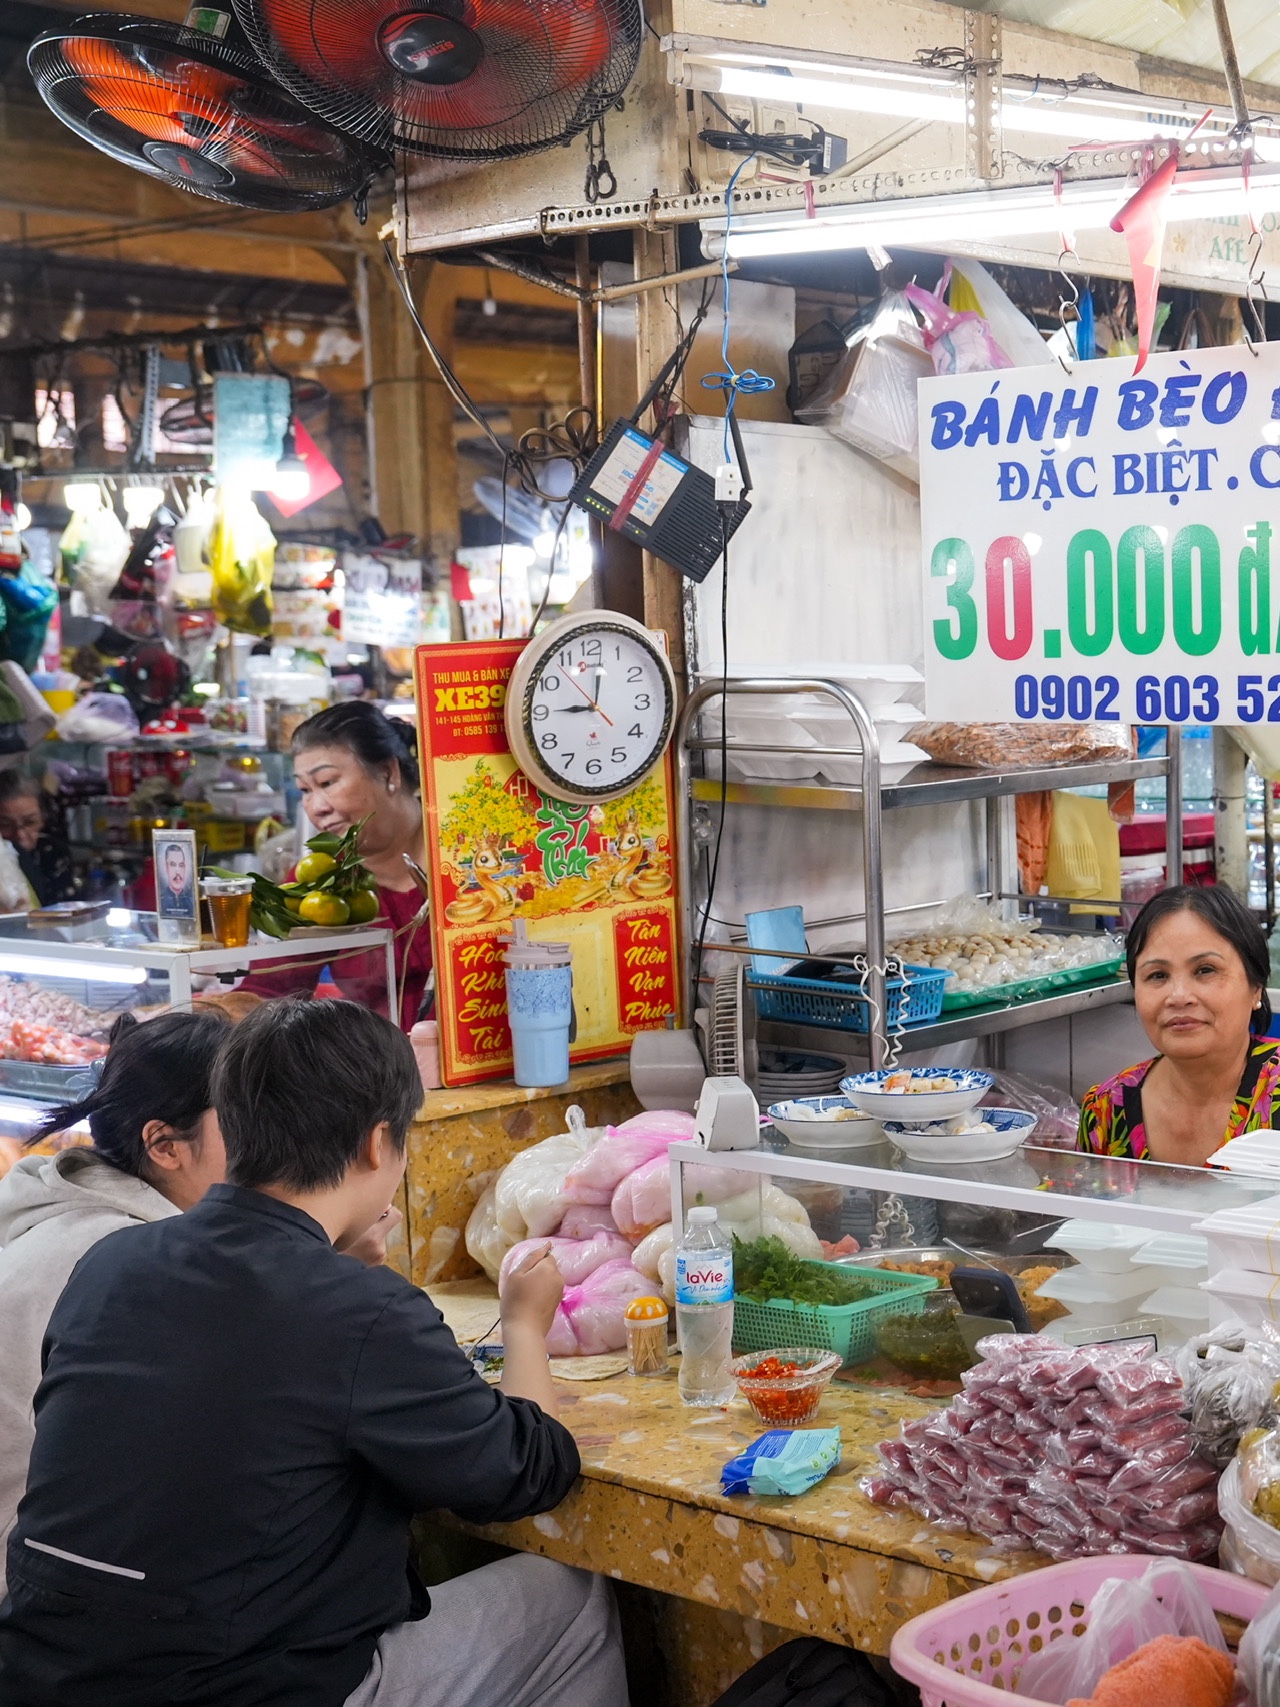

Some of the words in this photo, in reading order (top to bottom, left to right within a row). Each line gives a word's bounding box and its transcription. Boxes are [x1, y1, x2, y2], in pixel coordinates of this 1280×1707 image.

[931, 381, 1099, 451] BÁNH
[1117, 360, 1248, 432] BÈO
[997, 449, 1099, 511] ĐẶC
[930, 524, 1222, 661] 30.000
[580, 639, 602, 657] 12
[614, 645, 621, 661] 1
[560, 651, 573, 667] 11
[432, 672, 451, 685] THU
[451, 670, 472, 684] MUA
[472, 669, 481, 683] &
[480, 666, 499, 682] BÁN
[500, 666, 511, 680] XE
[539, 675, 560, 692] 10
[626, 666, 644, 683] 2
[634, 693, 651, 711] 3
[1014, 675, 1121, 722] 0902
[1135, 675, 1220, 722] 603
[434, 714, 462, 726] 141-145
[462, 713, 482, 725] HOÀNG
[482, 710, 496, 723] VĂN
[533, 704, 550, 721] 9
[463, 724, 483, 737] 0585
[483, 723, 498, 735] 139
[627, 722, 644, 739] 4
[541, 732, 558, 750] 8
[561, 752, 575, 770] 7
[610, 746, 628, 763] 5
[585, 758, 602, 775] 6
[624, 946, 667, 968] Niên
[629, 970, 666, 997] Vạn
[469, 1025, 503, 1051] Tài
[686, 1269, 723, 1284] laVie
